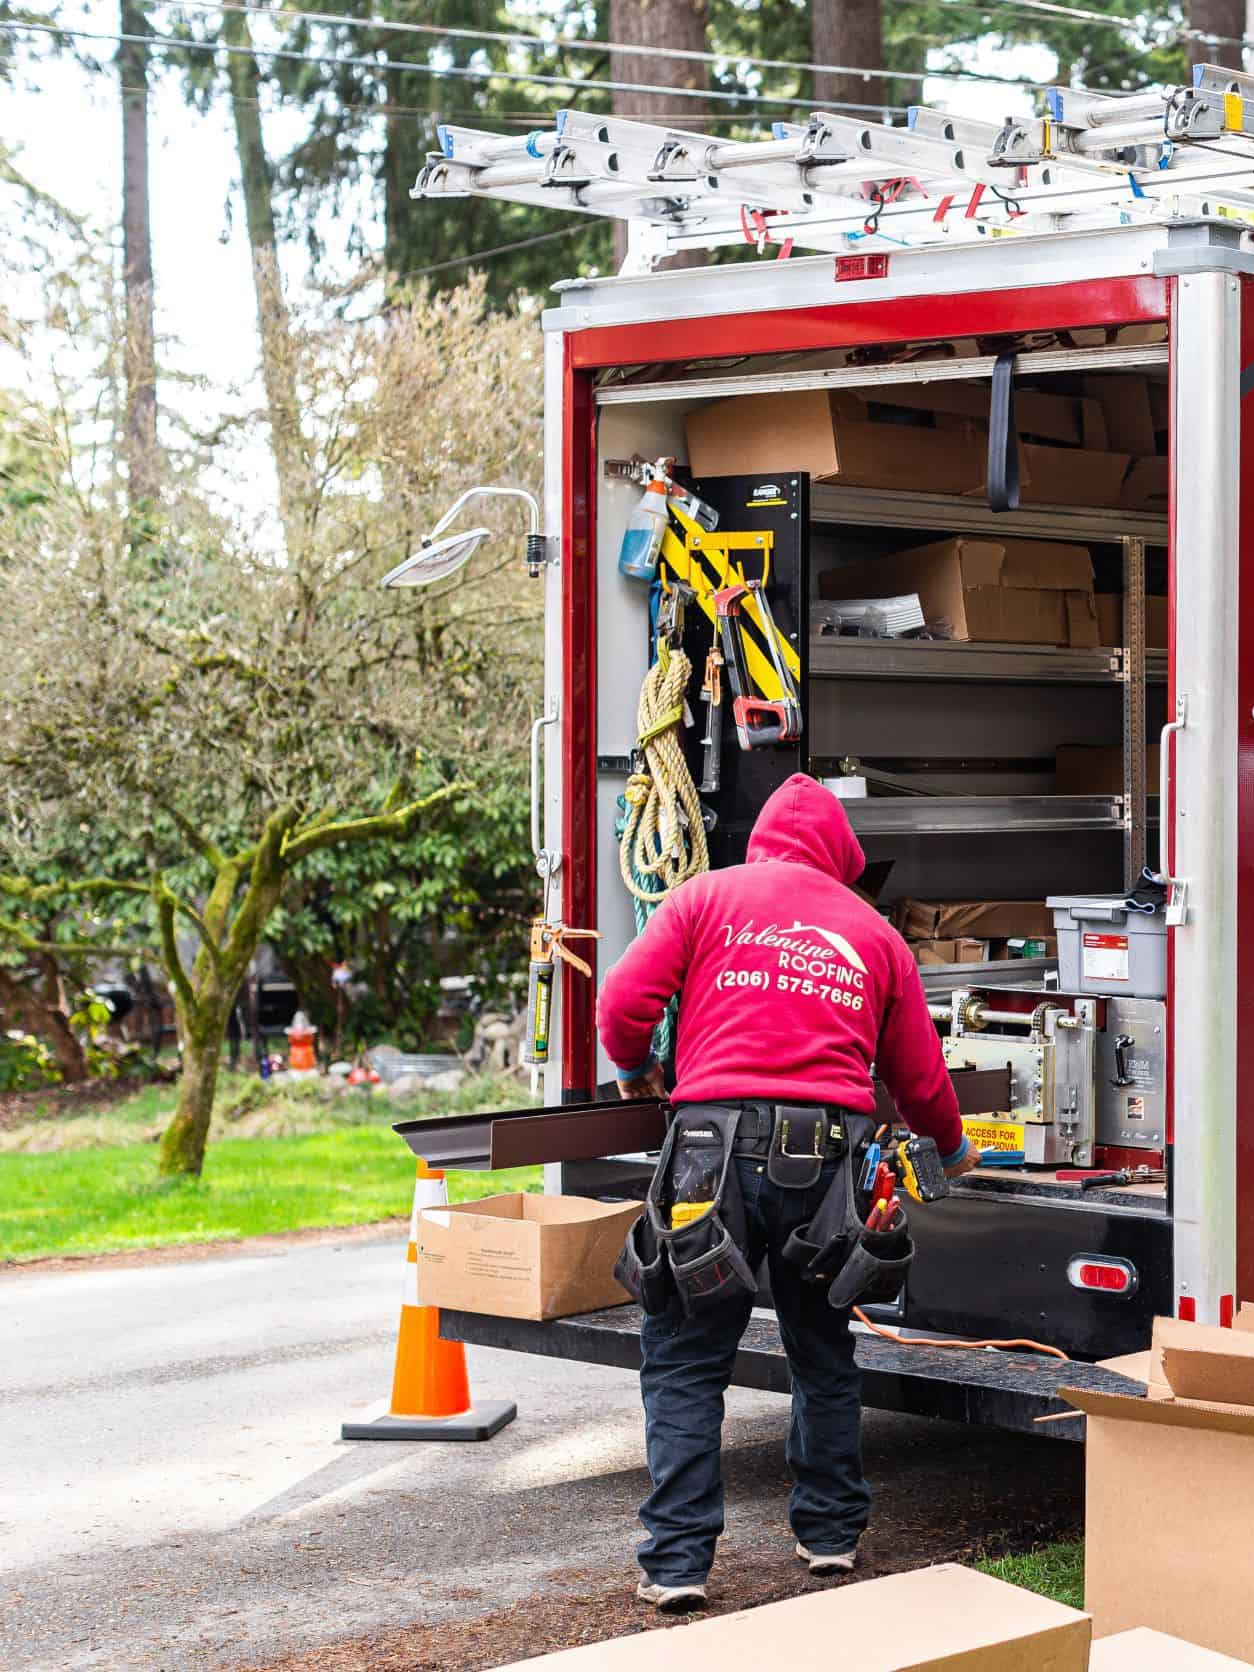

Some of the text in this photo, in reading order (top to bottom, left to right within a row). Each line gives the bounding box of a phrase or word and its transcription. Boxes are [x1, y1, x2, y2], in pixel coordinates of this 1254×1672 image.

[719, 919, 837, 959] Valentine
[777, 951, 864, 989] ROOFING
[716, 970, 864, 1011] (206) 575-7656
[966, 1127, 1016, 1141] ACCESS FOR
